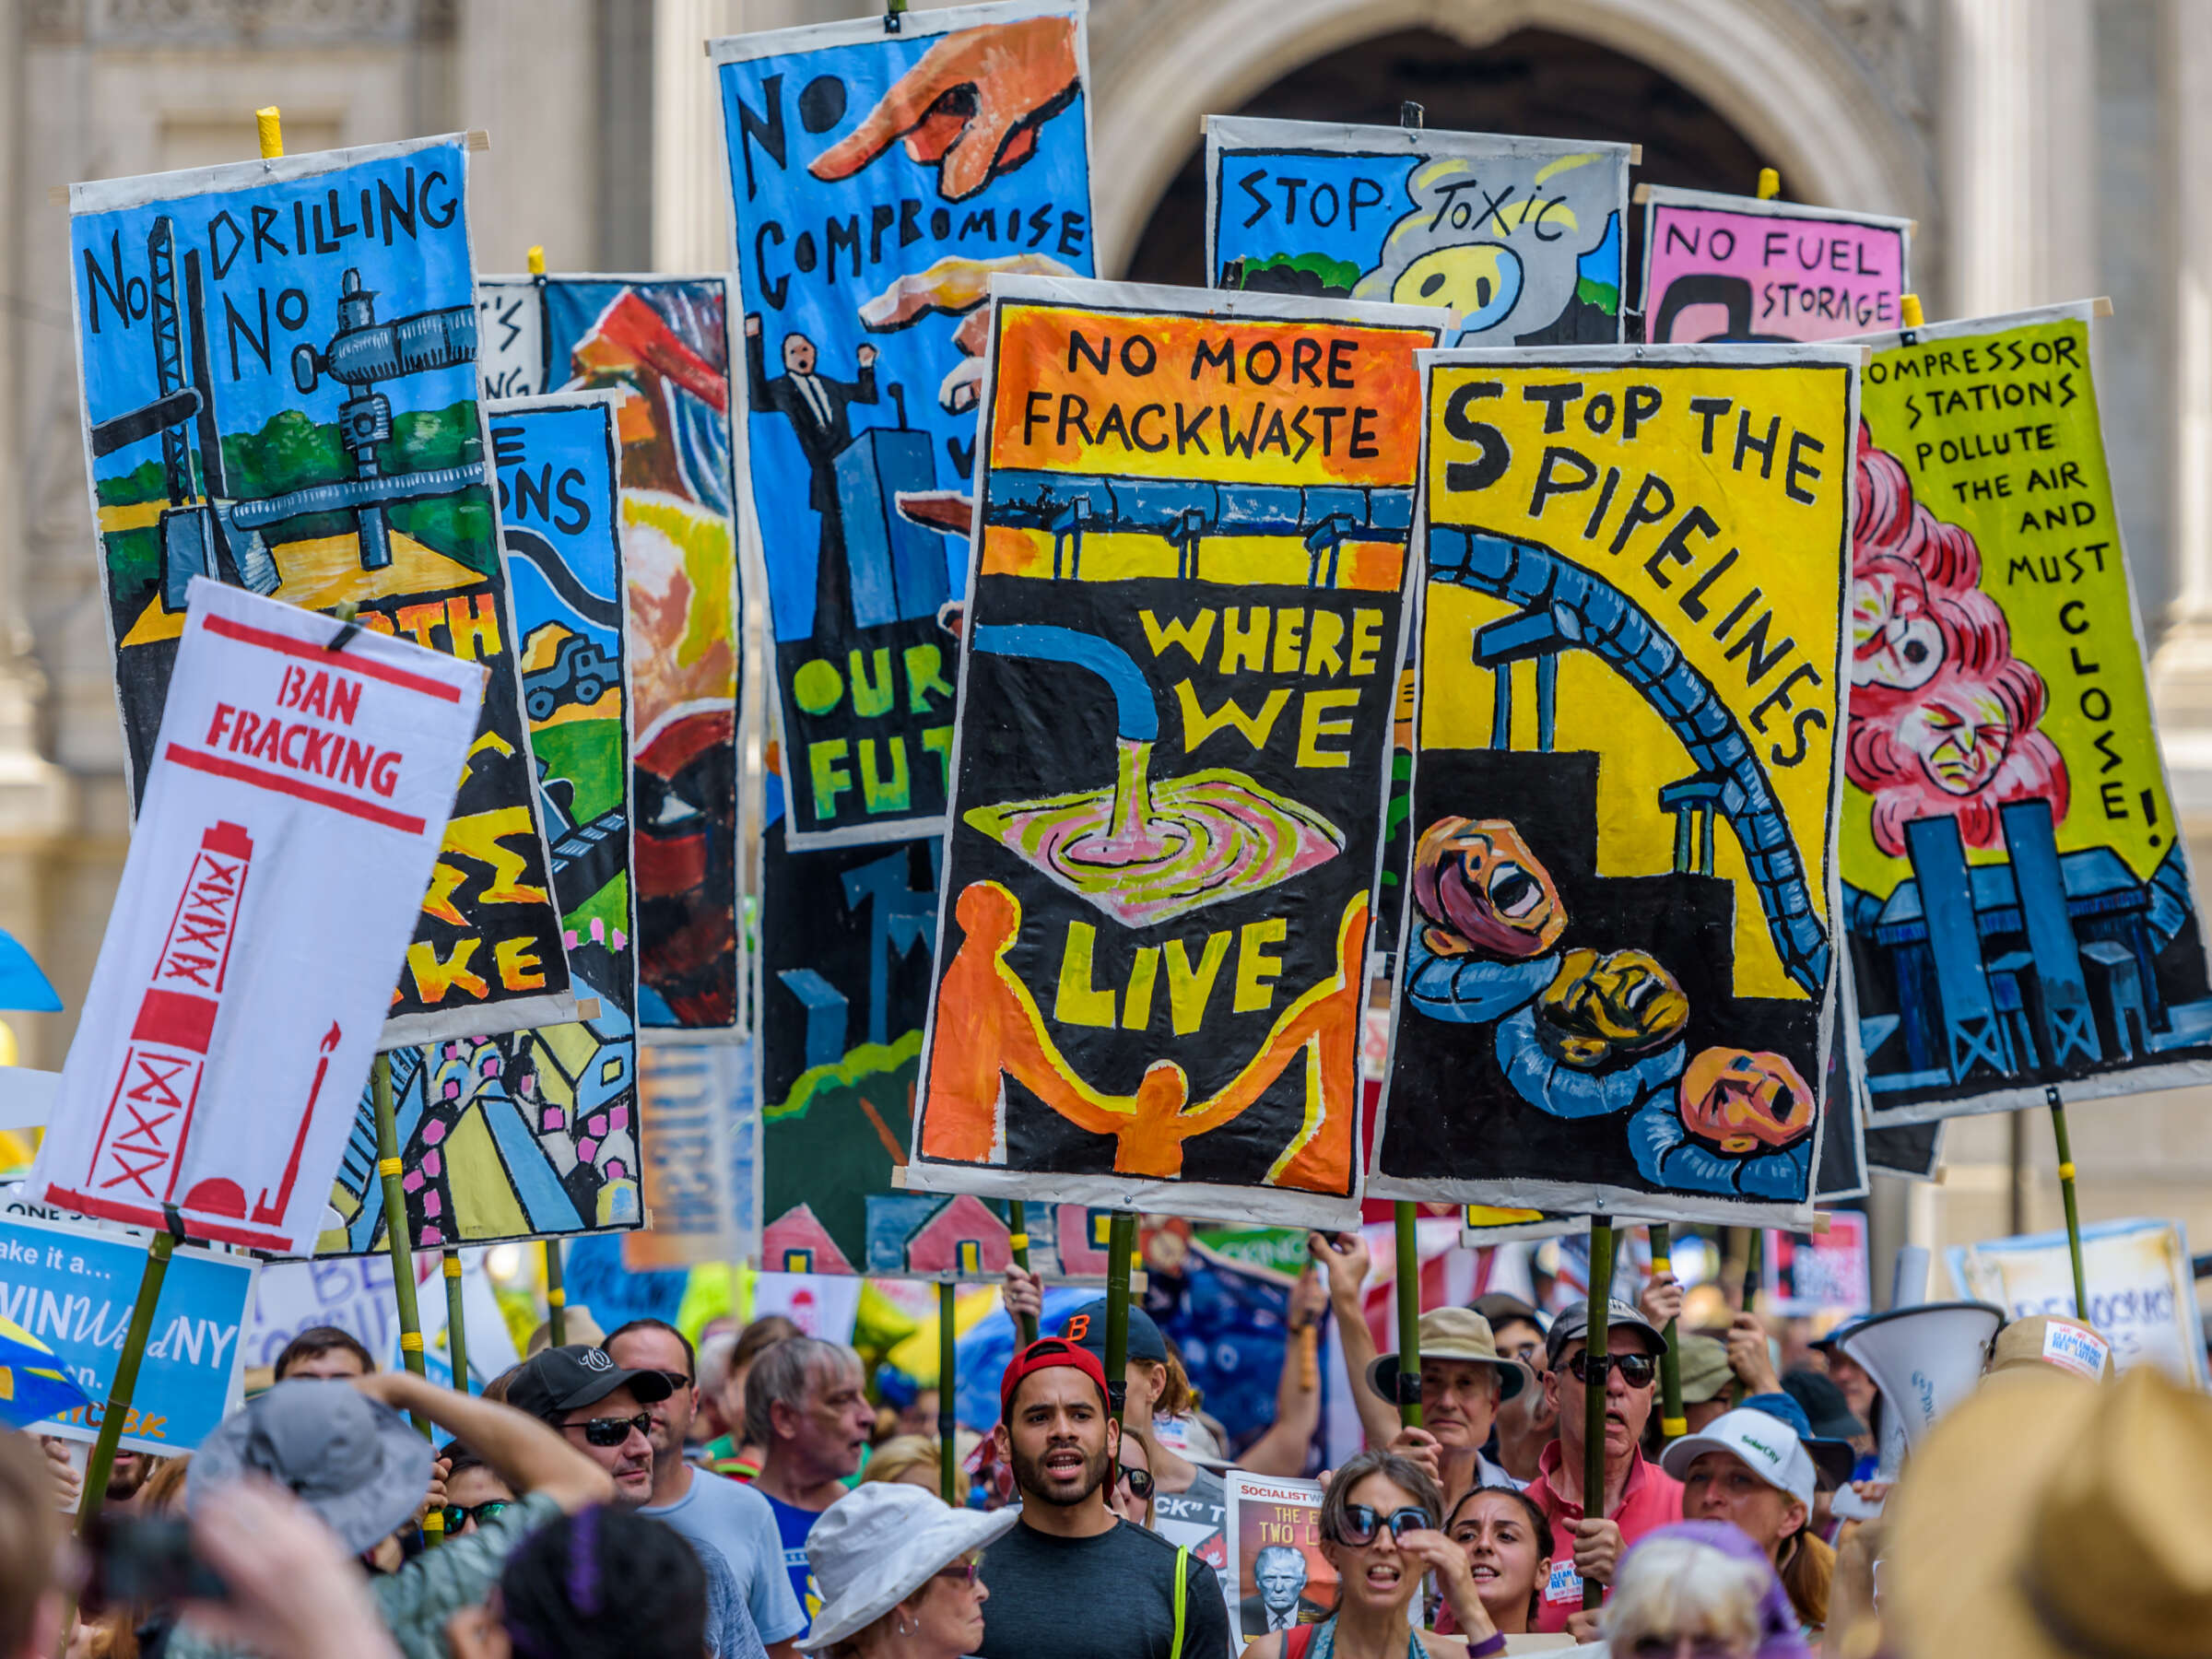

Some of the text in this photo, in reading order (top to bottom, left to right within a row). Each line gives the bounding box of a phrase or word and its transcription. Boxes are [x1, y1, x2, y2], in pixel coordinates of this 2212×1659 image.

[737, 73, 847, 202] NO
[207, 167, 457, 280] DRILLING
[1239, 169, 1382, 230] STOP
[756, 200, 1085, 311] COMPROMISE
[1665, 221, 1883, 276] NO FUEL
[1762, 283, 1893, 327] STORAGE
[1068, 330, 1359, 388] NO MORE
[1862, 335, 2081, 386] OMPRESSOR
[1023, 391, 1379, 464] FRACKWASTE
[1906, 373, 2077, 429] STATIONS
[1443, 382, 1825, 505] STOP THE
[1916, 424, 2055, 471] POLLUTE
[1953, 462, 2088, 503] THE AIR
[2019, 501, 2096, 534] AND
[2007, 542, 2110, 585] MUST
[1528, 446, 1827, 769] PIPELINES
[1138, 606, 1383, 677] WHERE
[276, 665, 362, 726] BAN
[794, 643, 954, 717] OUR
[205, 702, 403, 799] FRACKING
[1173, 678, 1362, 769] WE
[392, 936, 546, 1006] KE
[1053, 918, 1287, 1036] LIVE
[46, 1246, 64, 1270] it
[1066, 1314, 1090, 1342] B
[1741, 1434, 1782, 1465] SolarCity
[1259, 1522, 1294, 1545] TWO
[1275, 1506, 1323, 1525] THE E
